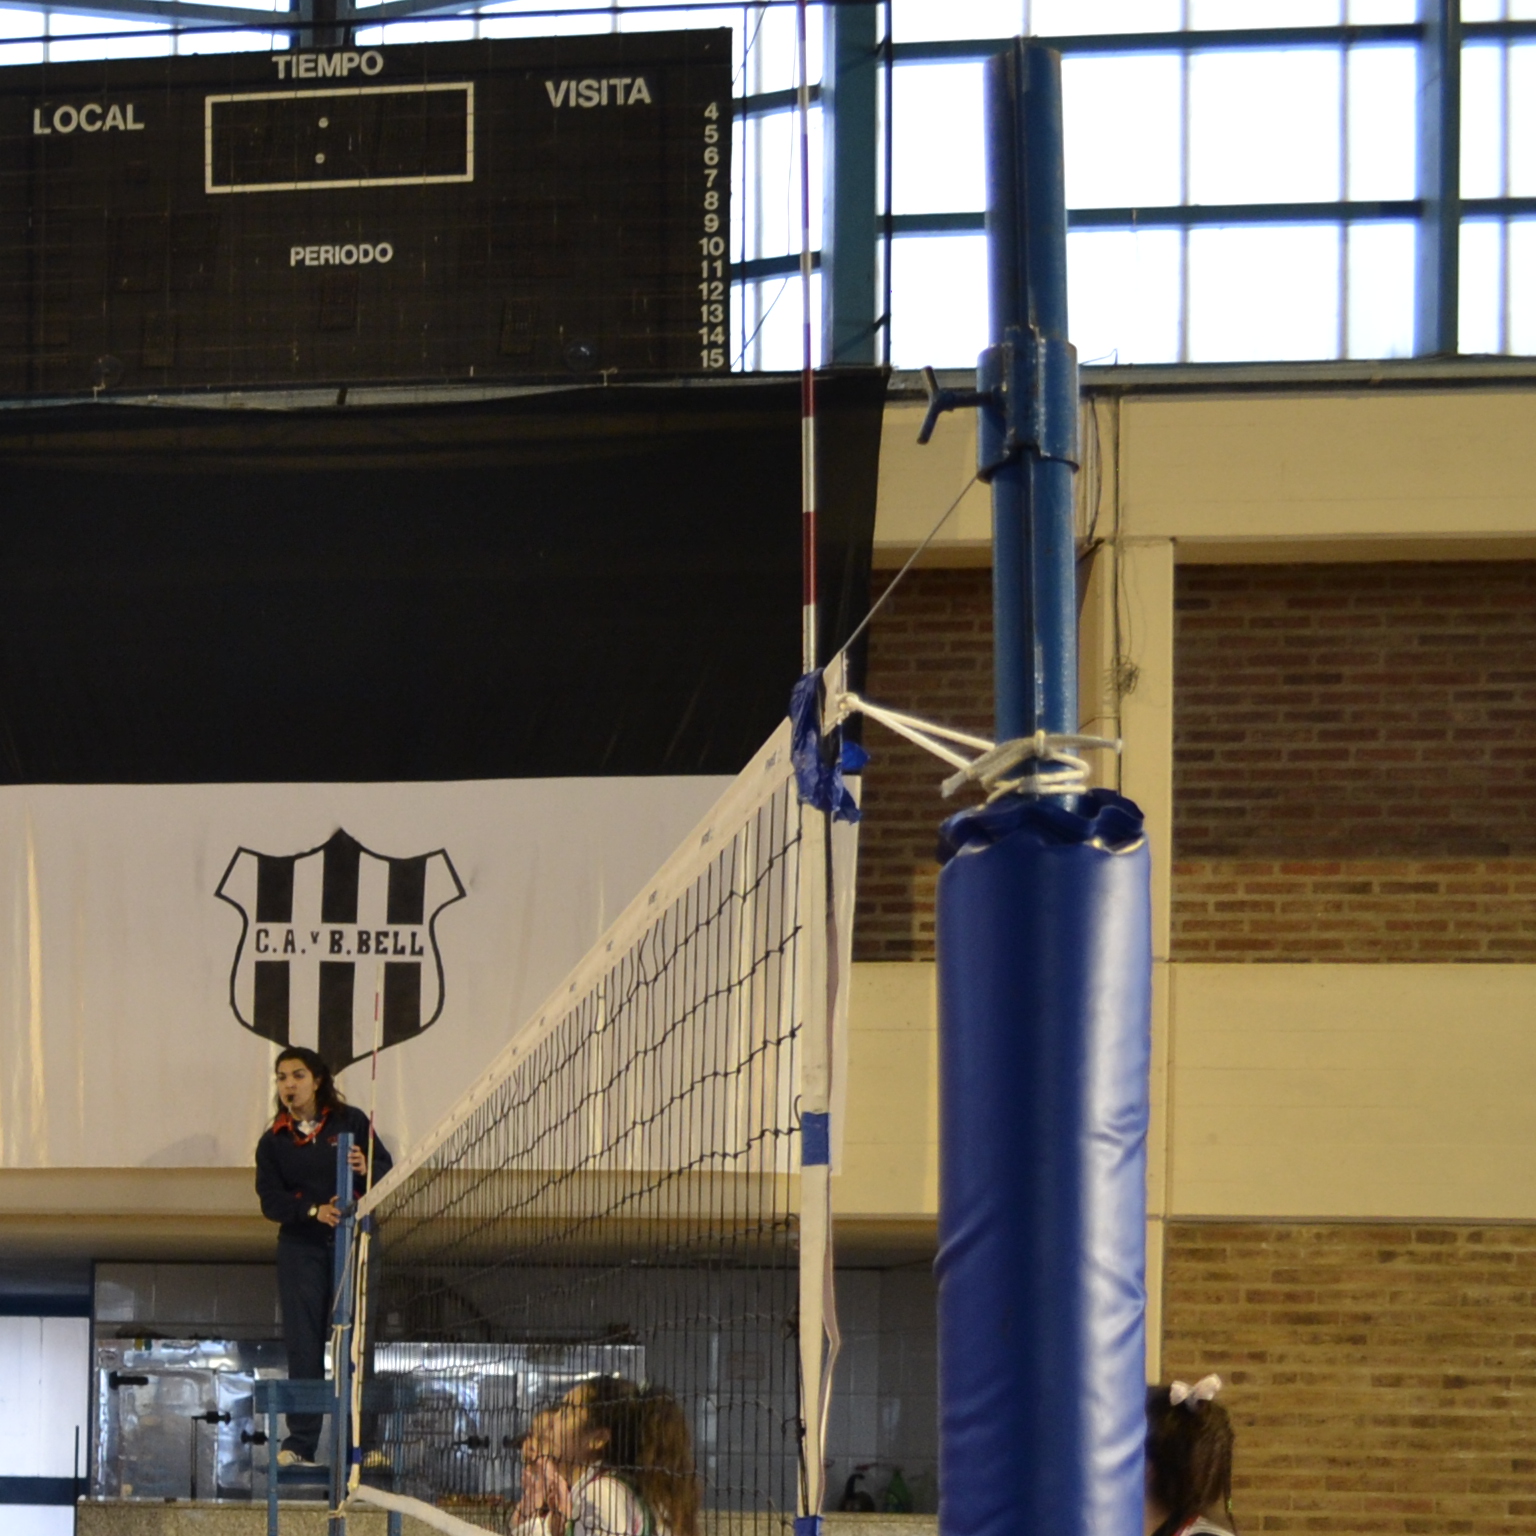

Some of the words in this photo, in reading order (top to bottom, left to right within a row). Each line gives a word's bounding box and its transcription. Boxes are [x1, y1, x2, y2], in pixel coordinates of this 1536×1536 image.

[272, 50, 384, 80] TIEMPO
[544, 77, 652, 109] VISITA
[33, 103, 145, 135] LOCAL
[704, 101, 719, 121] 4
[704, 124, 719, 144] 5
[703, 146, 720, 166] 6
[703, 168, 718, 188] 7
[703, 190, 719, 211] 8
[703, 212, 720, 233] 9
[290, 242, 394, 267] PERIODO
[698, 236, 725, 256] 10
[701, 259, 723, 279] 11
[698, 280, 724, 301] 12
[700, 303, 724, 323] 13
[698, 326, 726, 345] 14
[700, 348, 725, 368] 15
